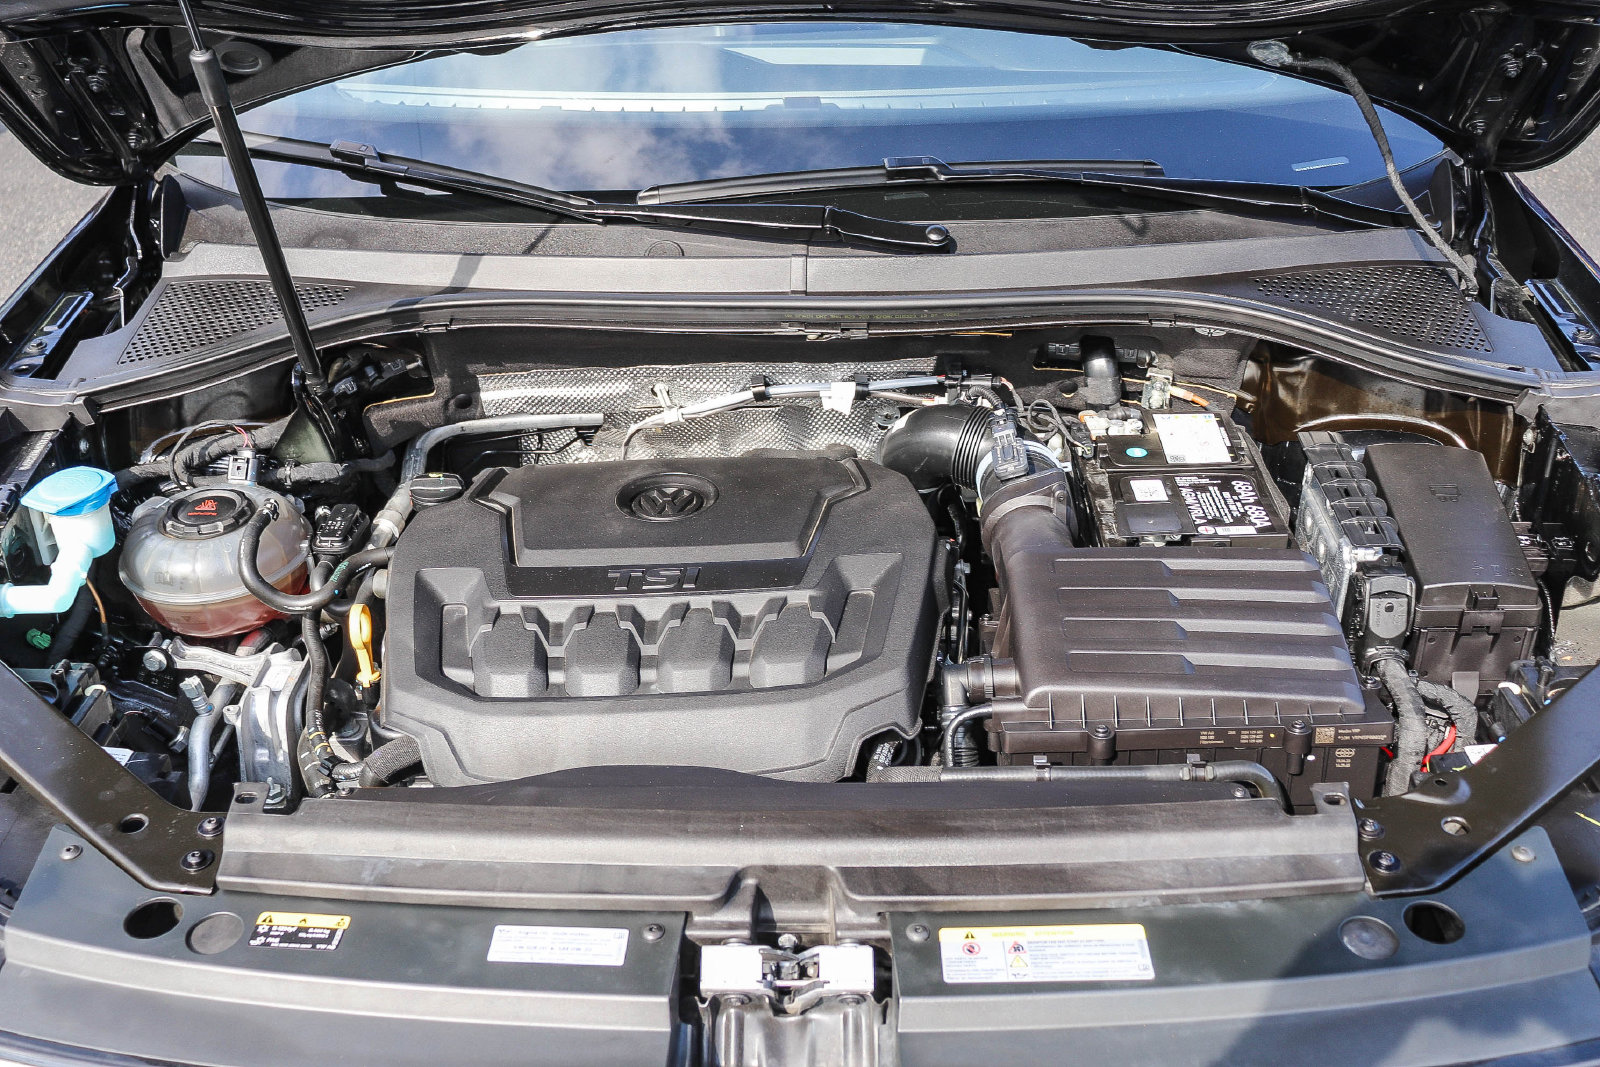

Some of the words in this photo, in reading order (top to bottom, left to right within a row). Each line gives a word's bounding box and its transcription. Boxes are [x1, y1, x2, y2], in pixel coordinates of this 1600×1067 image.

[1231, 480, 1258, 504] 68Ah
[1244, 505, 1272, 528] 680A
[608, 567, 702, 591] TSI
